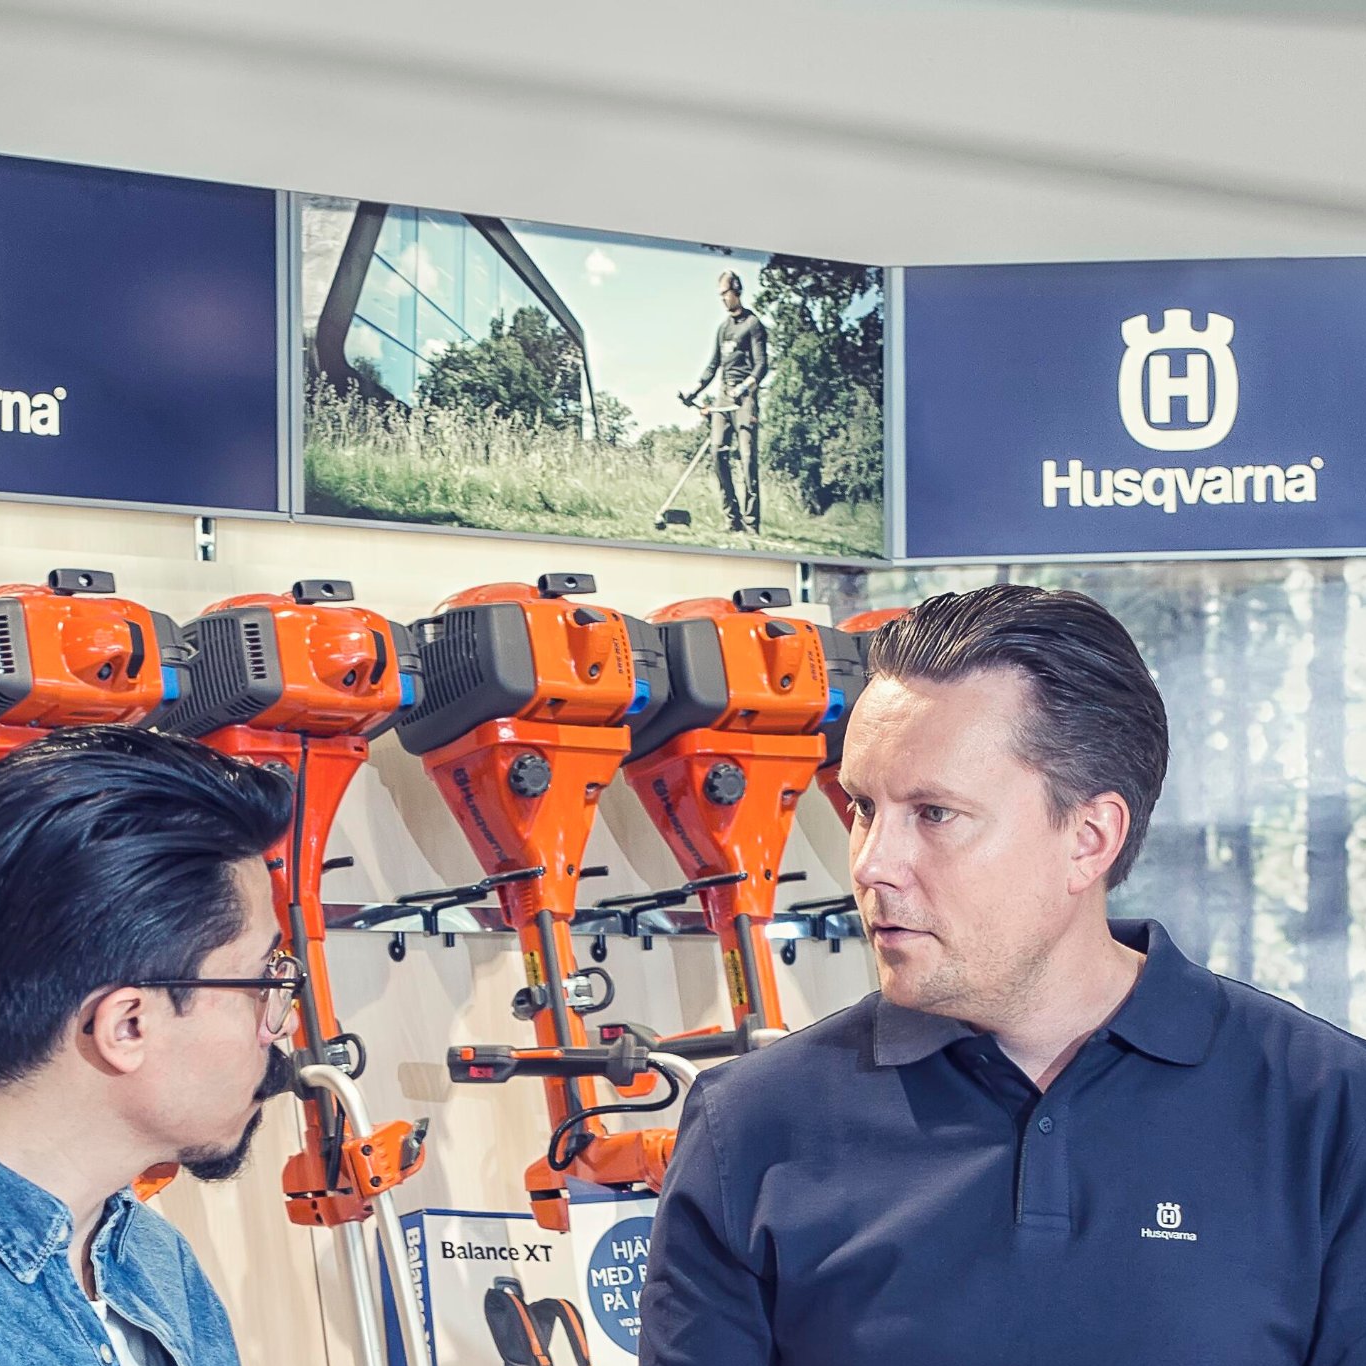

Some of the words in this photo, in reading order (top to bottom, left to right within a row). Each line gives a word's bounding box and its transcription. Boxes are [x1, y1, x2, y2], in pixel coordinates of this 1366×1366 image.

[1042, 459, 1317, 513] Husqvarna
[1141, 1228, 1197, 1241] Husqvarna
[441, 1241, 519, 1262] Balance
[525, 1244, 552, 1262] XT
[590, 1266, 635, 1287] MED
[602, 1287, 629, 1312] PÅ
